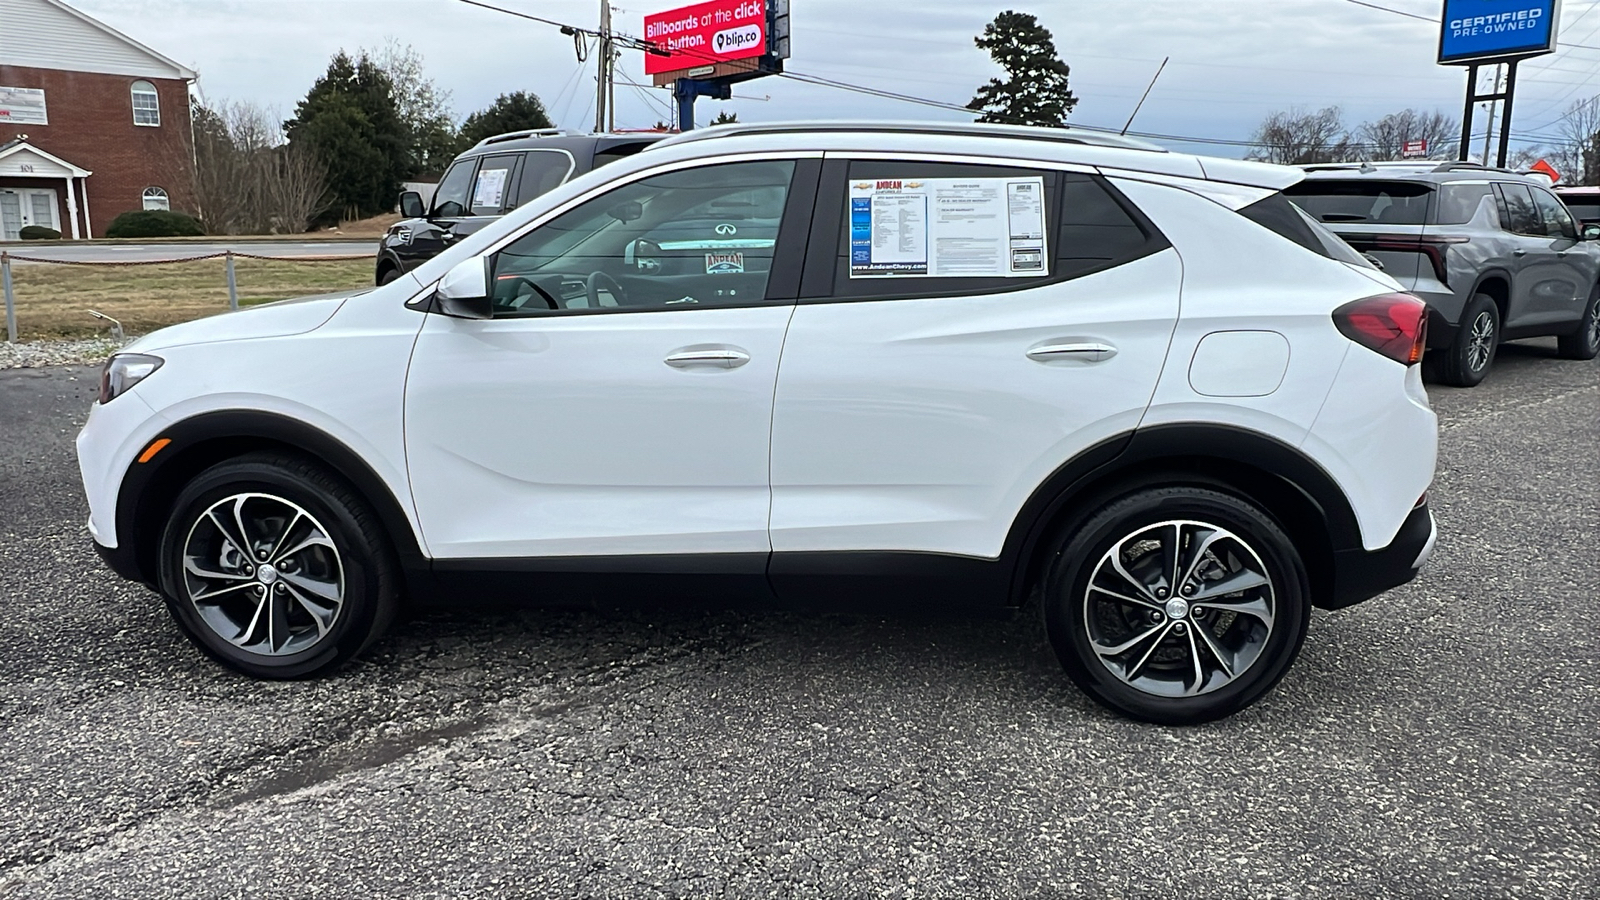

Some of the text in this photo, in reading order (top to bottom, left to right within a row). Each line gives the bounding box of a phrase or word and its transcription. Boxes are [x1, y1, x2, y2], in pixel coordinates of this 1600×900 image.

[647, 0, 761, 38] Billboards at the click
[1450, 8, 1542, 29] CERTIFIED
[1453, 19, 1536, 38] PRE-OWNED
[668, 34, 706, 50] button.
[726, 32, 757, 47] blip.co
[875, 181, 902, 190] ANDEAN
[707, 253, 742, 267] ANDEAN
